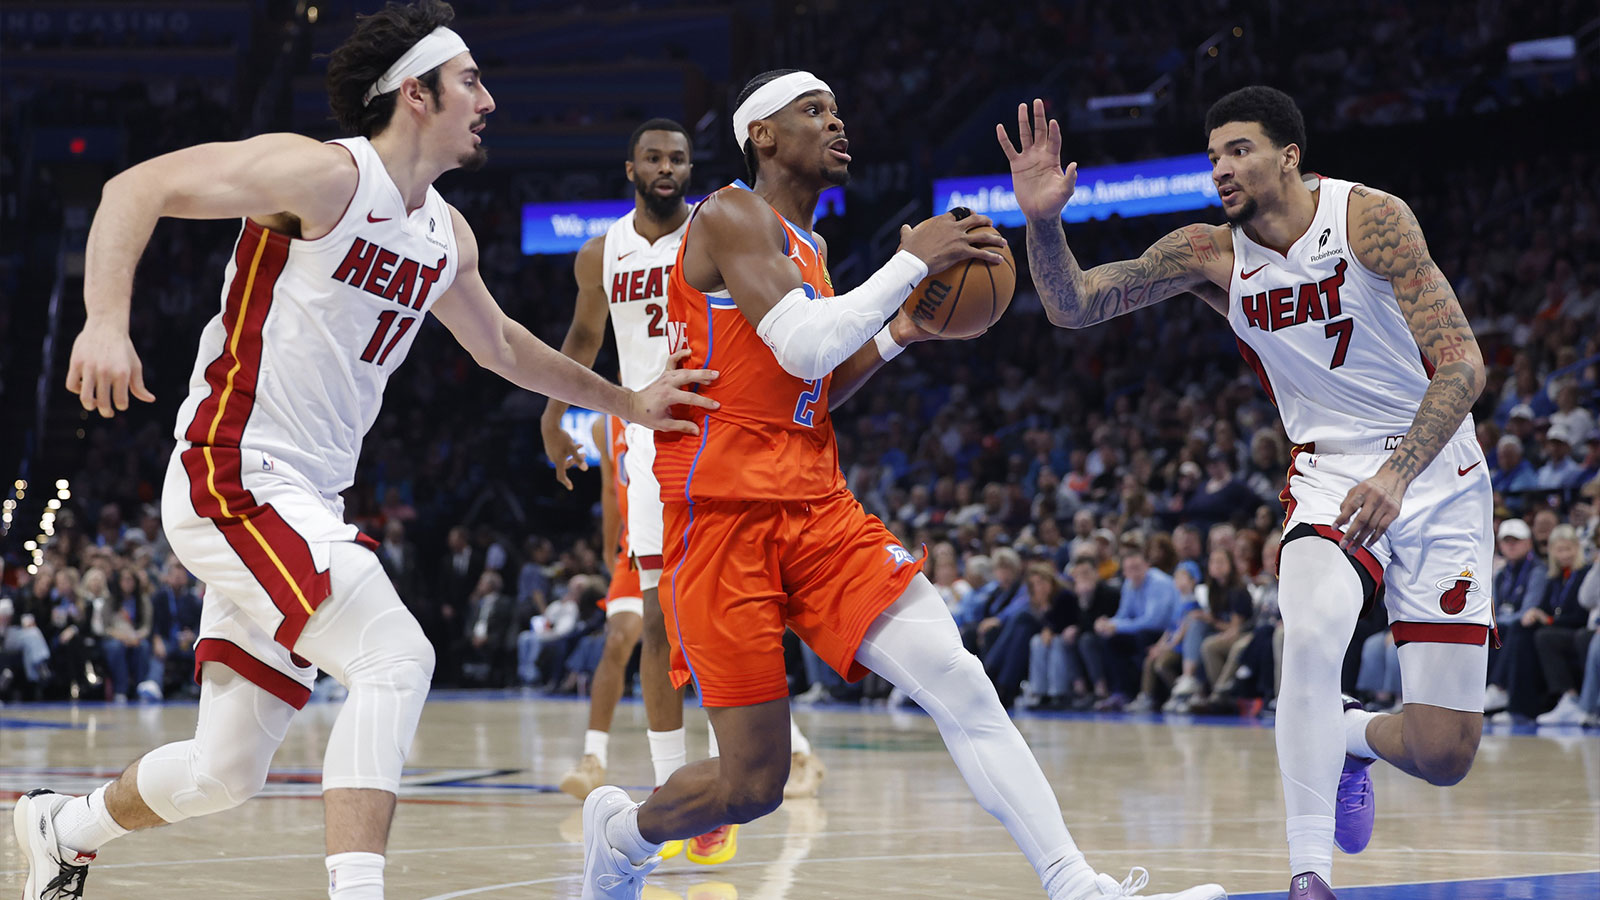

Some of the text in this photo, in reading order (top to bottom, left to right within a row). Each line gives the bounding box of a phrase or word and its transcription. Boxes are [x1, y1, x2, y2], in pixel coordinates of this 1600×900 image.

[66, 12, 190, 32] CASINO
[551, 214, 586, 238] We
[331, 236, 448, 312] HEAT
[1310, 247, 1344, 262] Robinhood
[1241, 257, 1348, 332] HEAT
[360, 310, 416, 367] 11
[645, 303, 668, 338] 2
[1324, 317, 1354, 370] 7
[793, 377, 823, 428] 2
